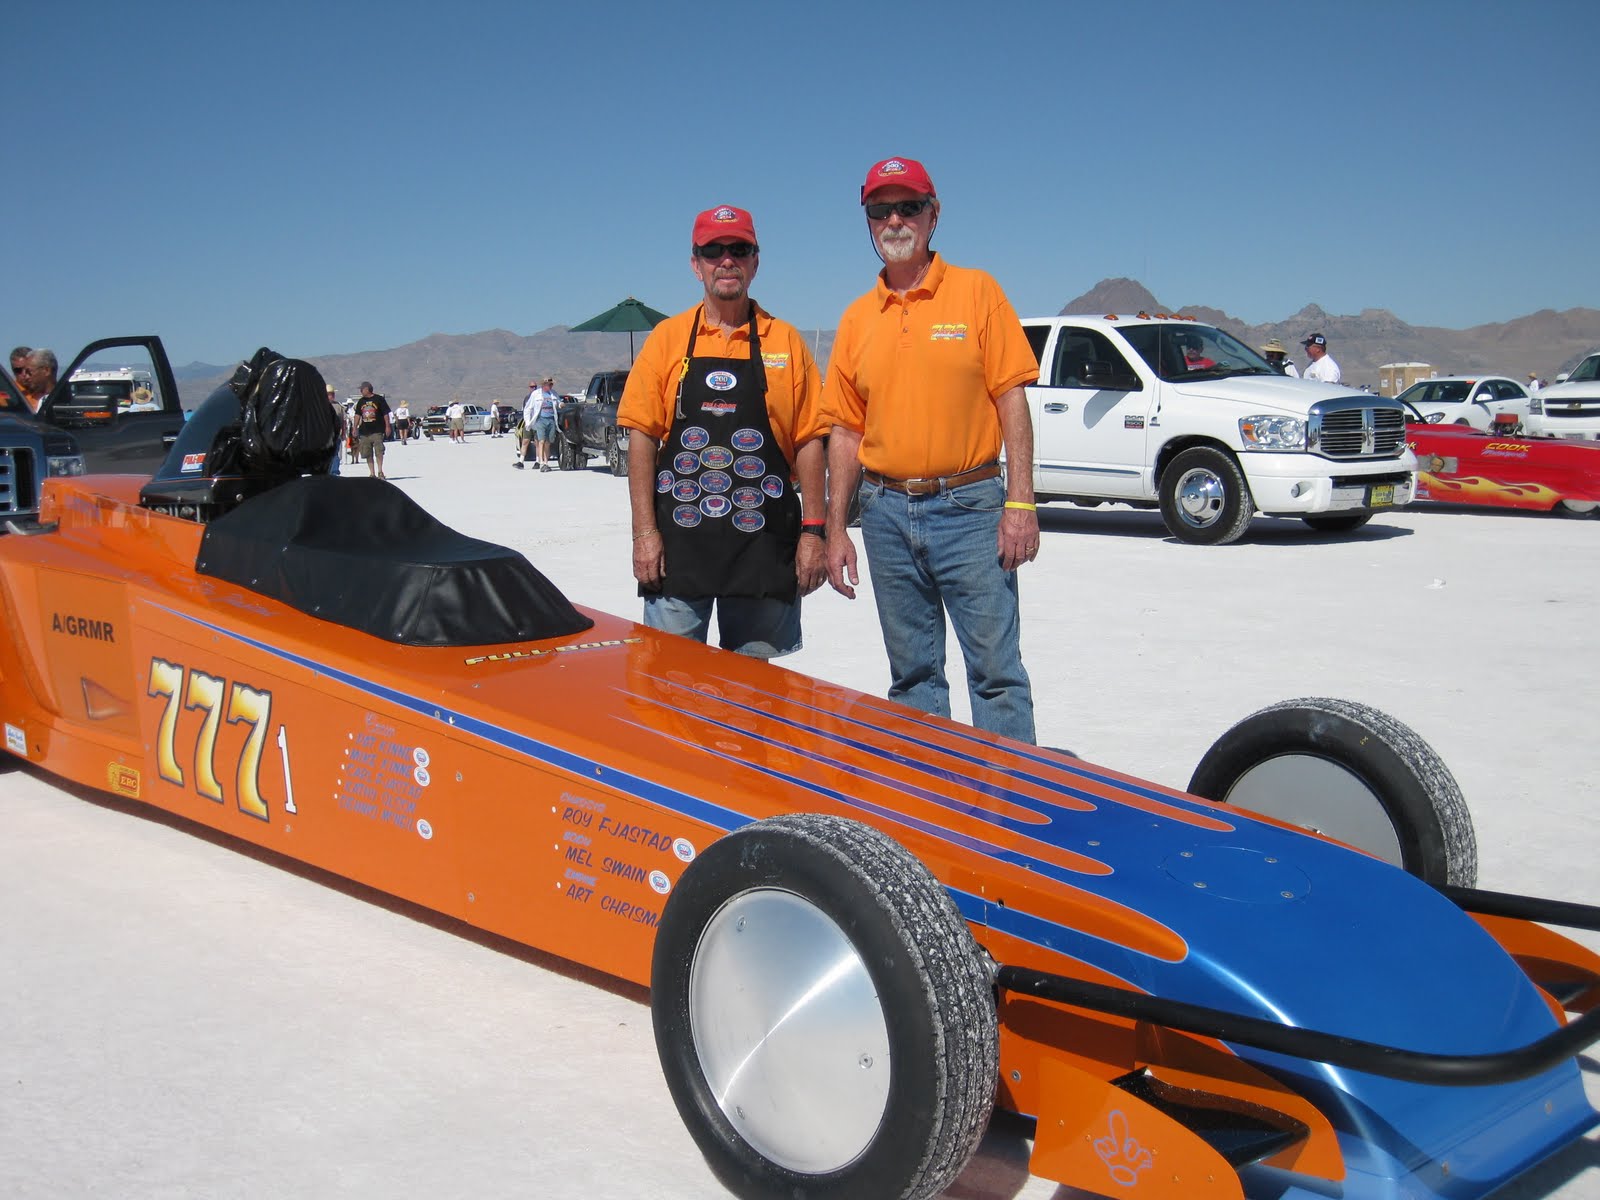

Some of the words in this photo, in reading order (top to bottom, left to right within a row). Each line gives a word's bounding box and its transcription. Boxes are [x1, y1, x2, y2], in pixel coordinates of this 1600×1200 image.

[1485, 442, 1532, 452] COOK
[52, 613, 115, 643] A/GRMR
[147, 656, 272, 823] 777
[277, 724, 297, 815] 1
[562, 807, 593, 828] ROY
[598, 817, 673, 852] FJASTAD
[565, 846, 593, 868] MEL
[600, 857, 647, 884] SWAIN
[566, 884, 594, 903] ART
